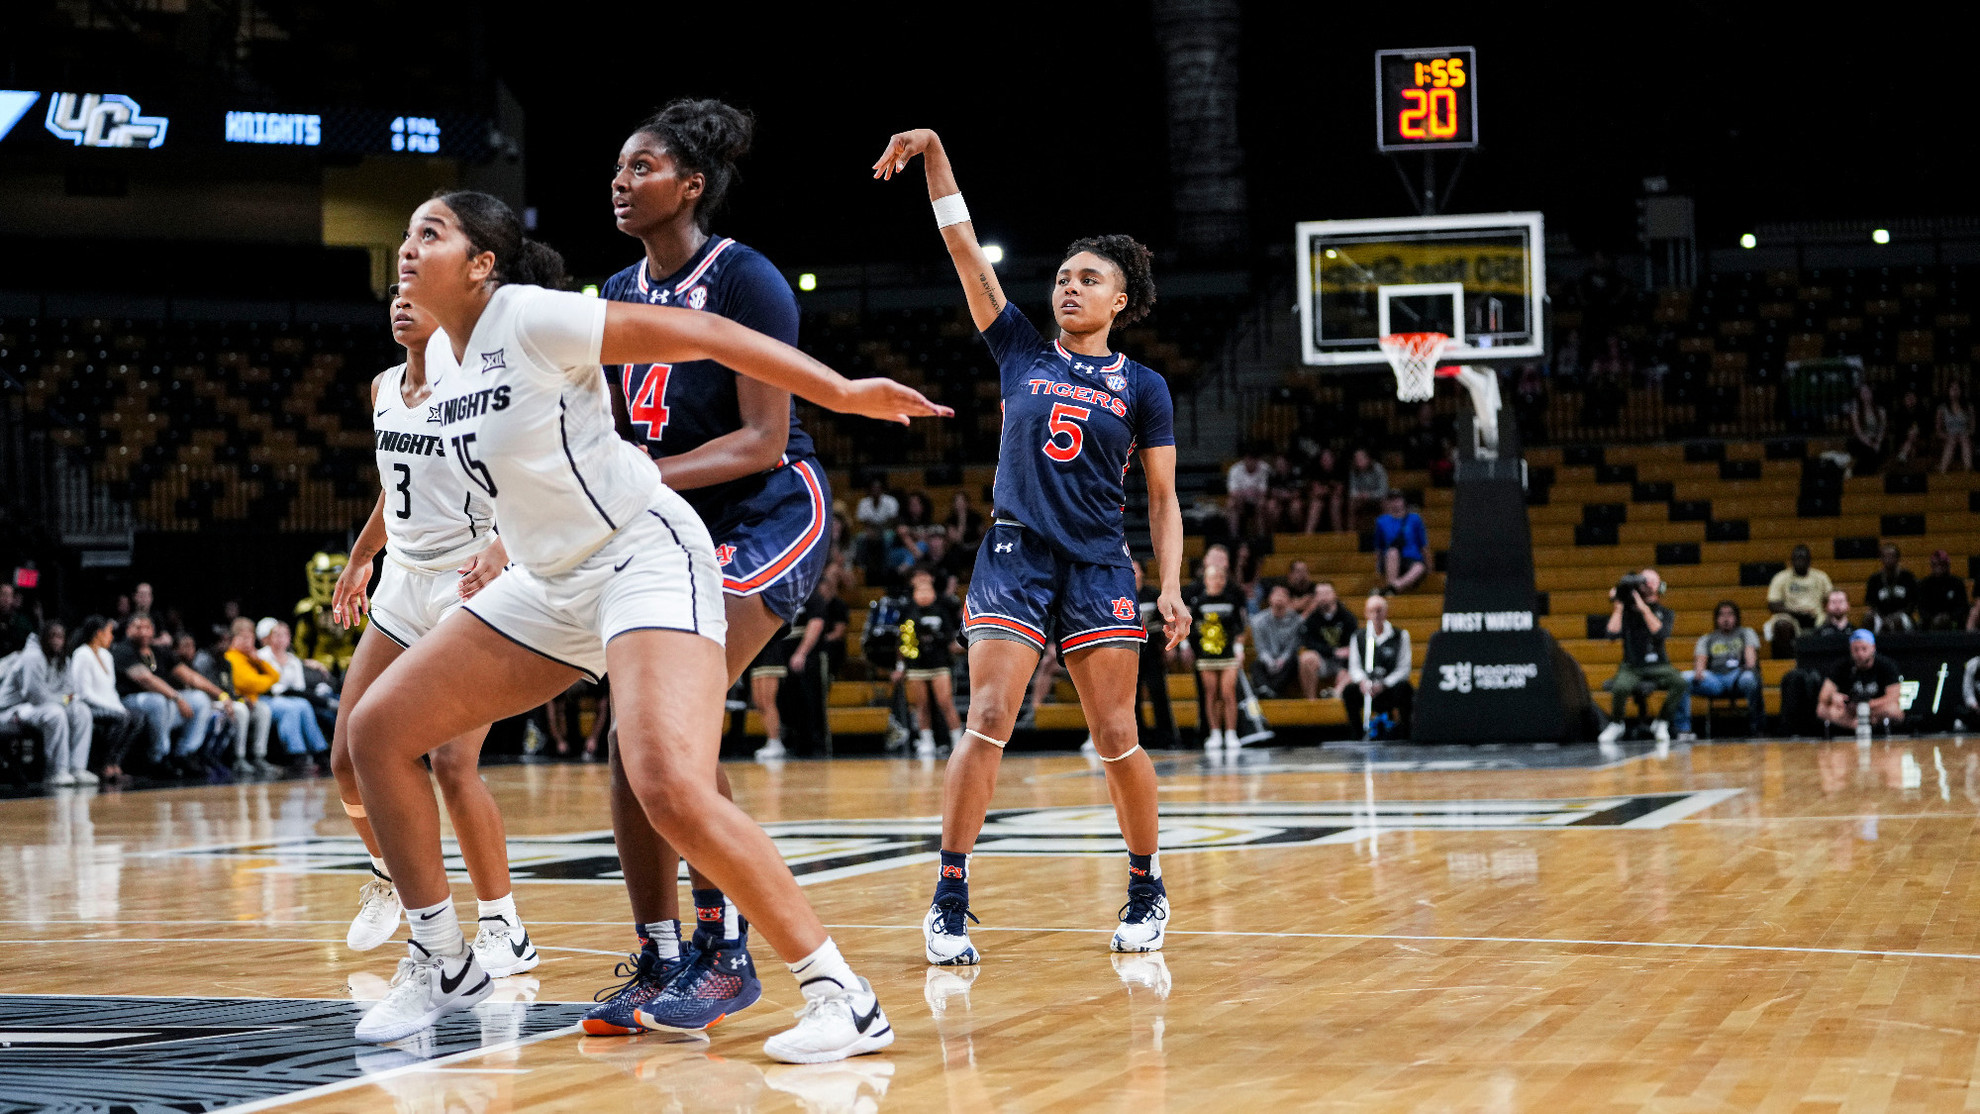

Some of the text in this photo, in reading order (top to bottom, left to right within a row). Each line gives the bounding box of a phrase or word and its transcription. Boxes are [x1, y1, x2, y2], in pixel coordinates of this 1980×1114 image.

[1415, 58, 1466, 88] 1:55
[45, 92, 169, 148] UCF
[225, 111, 321, 145] KNIGHTS
[390, 116, 405, 133] 4
[1399, 87, 1457, 139] 20
[1028, 379, 1127, 418] TIGERS
[1042, 402, 1091, 462] 5
[451, 432, 498, 498] 15
[394, 463, 411, 520] 3
[1442, 610, 1533, 632] FIRST WATCH
[1473, 663, 1538, 679] ROOFING
